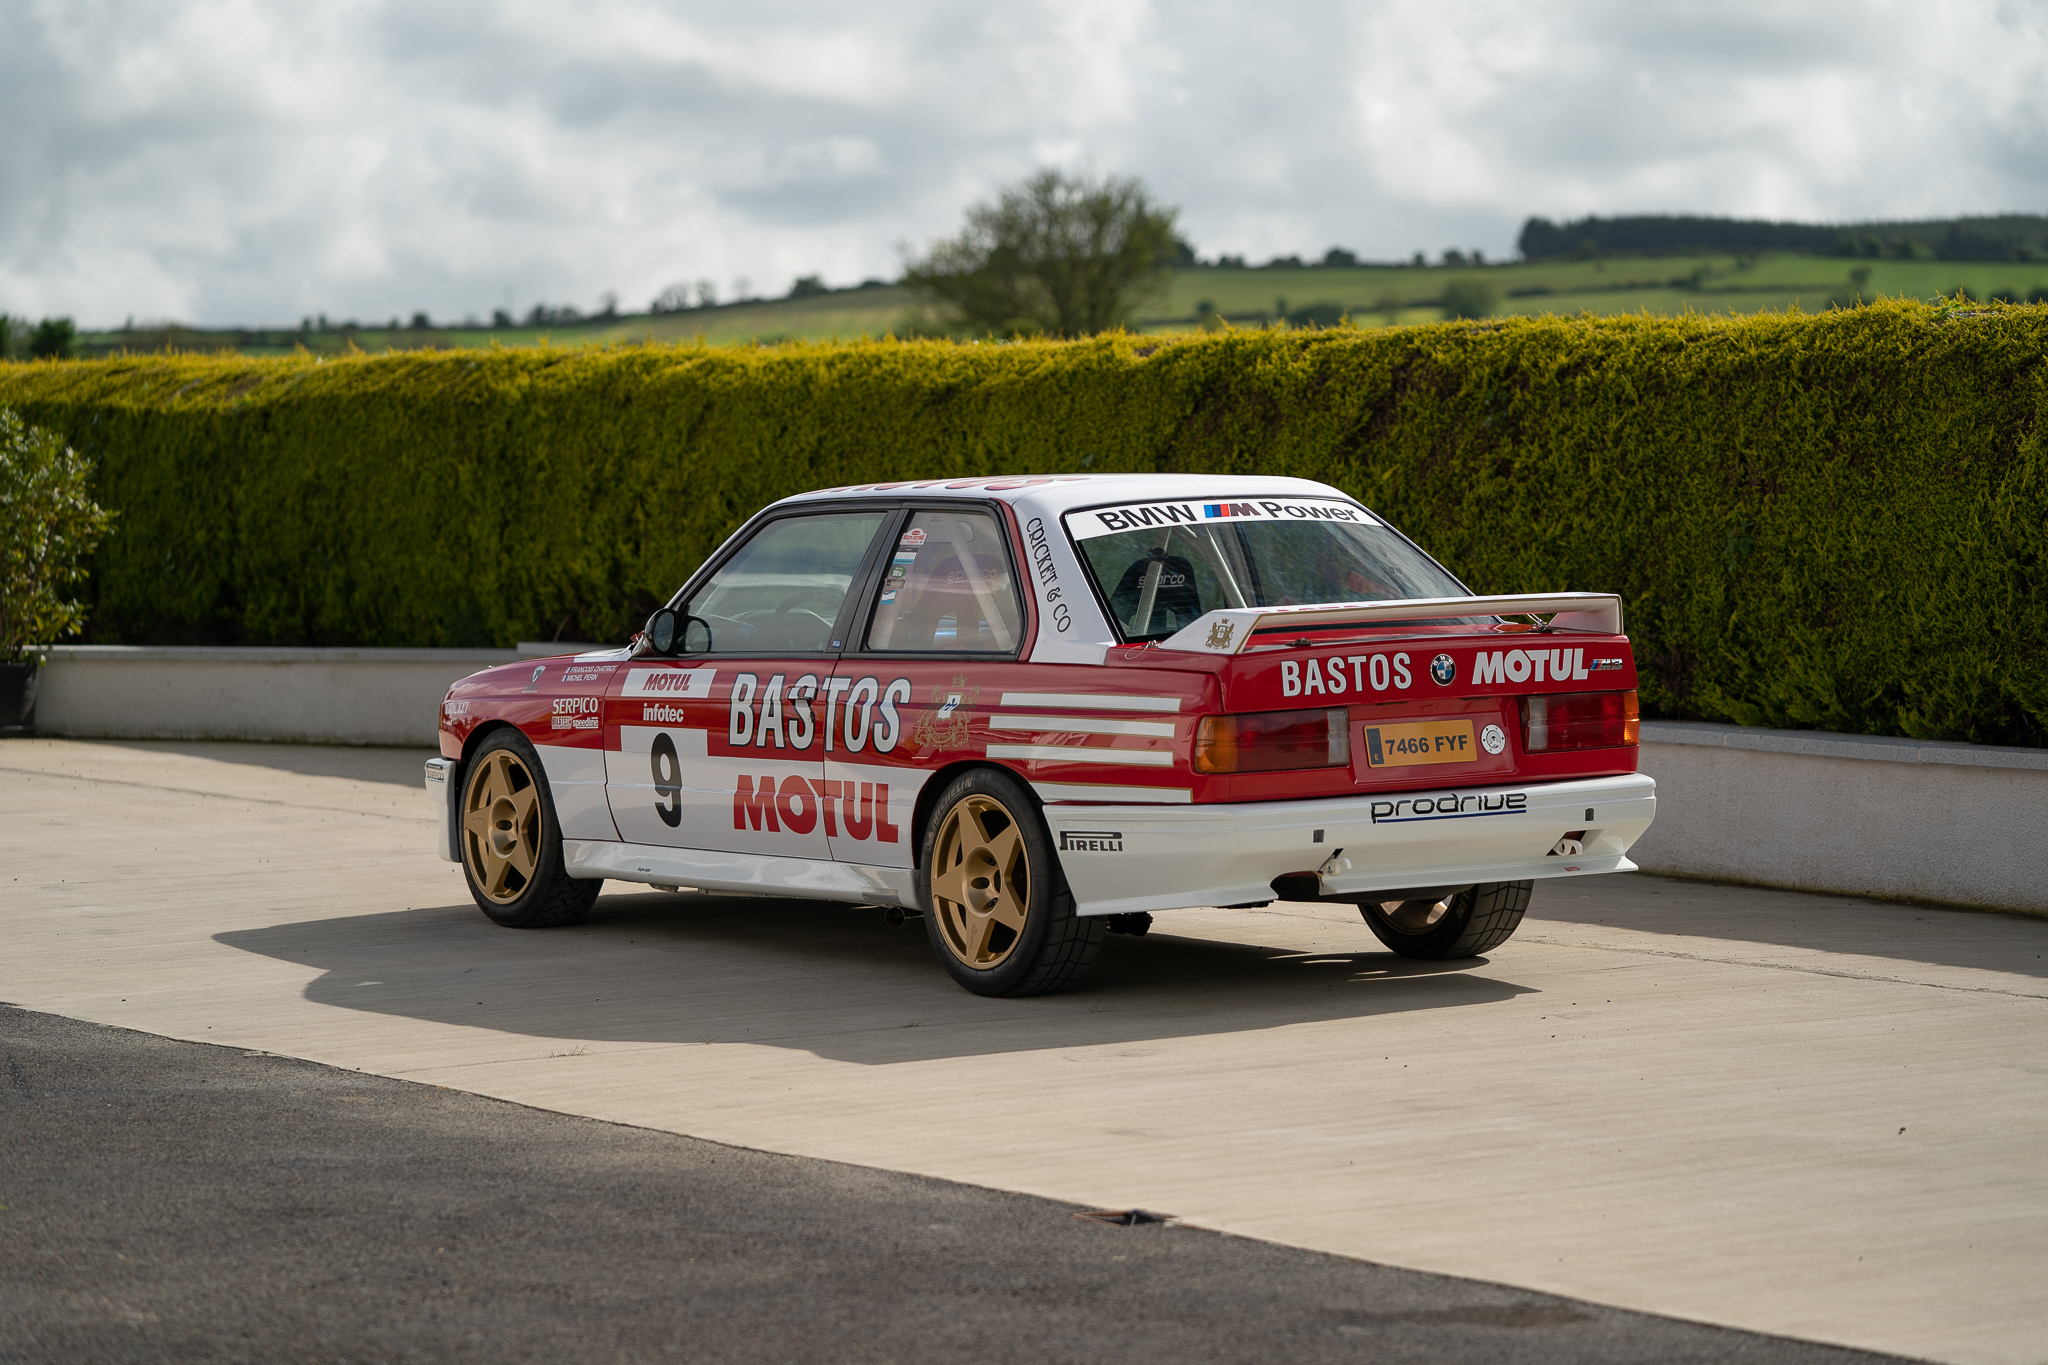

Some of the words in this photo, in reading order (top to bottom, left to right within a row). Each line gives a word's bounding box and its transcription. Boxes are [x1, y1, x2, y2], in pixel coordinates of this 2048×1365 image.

[1096, 504, 1198, 531] BMW
[1261, 501, 1360, 522] Power
[1027, 517, 1058, 587] CRICKET
[1046, 586, 1062, 602] &
[1053, 603, 1071, 633] CO
[1281, 652, 1412, 697] BASTOS
[1472, 648, 1589, 685] MOTUL
[642, 673, 692, 692] MOTUL
[552, 697, 599, 714] SERPICO
[643, 703, 684, 722] infotec
[729, 673, 912, 753] BASTOS
[1385, 737, 1430, 756] 7466
[1434, 734, 1468, 752] FYF
[651, 732, 683, 828] 9
[734, 775, 899, 843] MOTUL
[931, 775, 975, 829] MICHELIN
[1371, 792, 1527, 824] prodrive
[1059, 831, 1123, 852] PIRELLI
